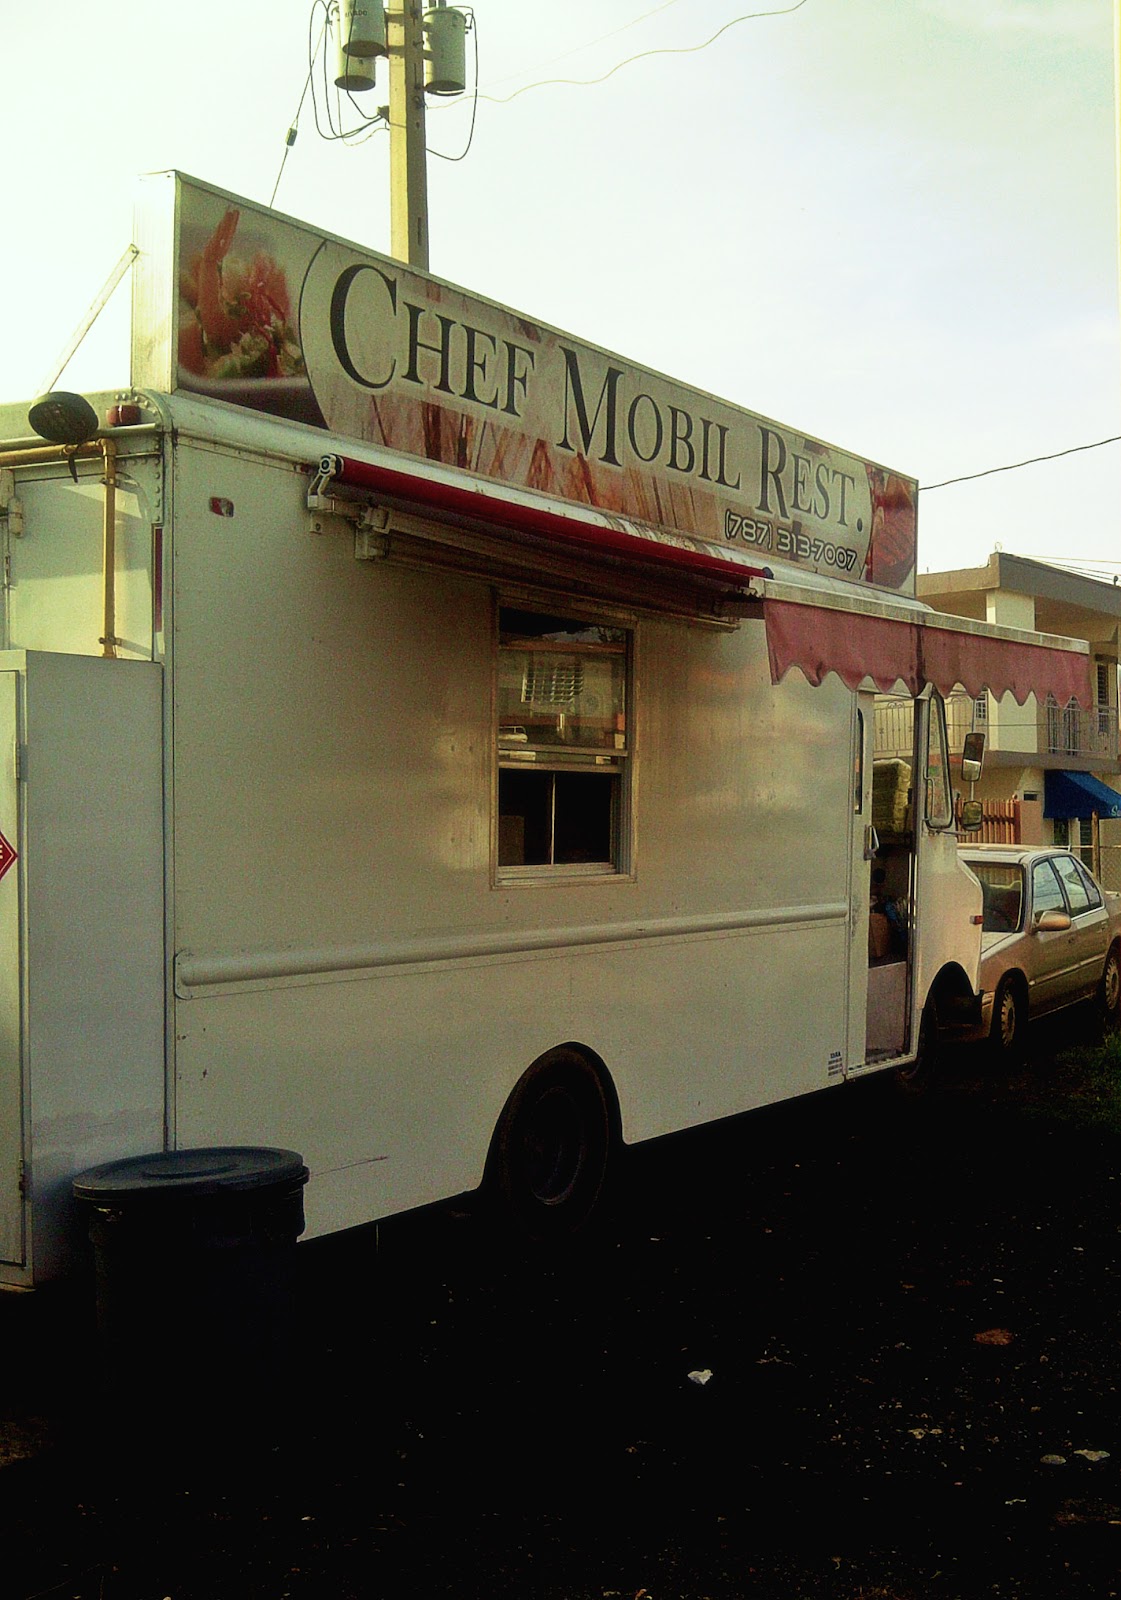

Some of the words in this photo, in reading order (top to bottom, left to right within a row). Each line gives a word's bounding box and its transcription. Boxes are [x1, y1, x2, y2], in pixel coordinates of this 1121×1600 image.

[329, 263, 535, 418] CHEF
[556, 345, 741, 490] MOBIL
[755, 424, 863, 533] REST.
[724, 508, 773, 550] (787)
[776, 527, 858, 572] 313-7007
